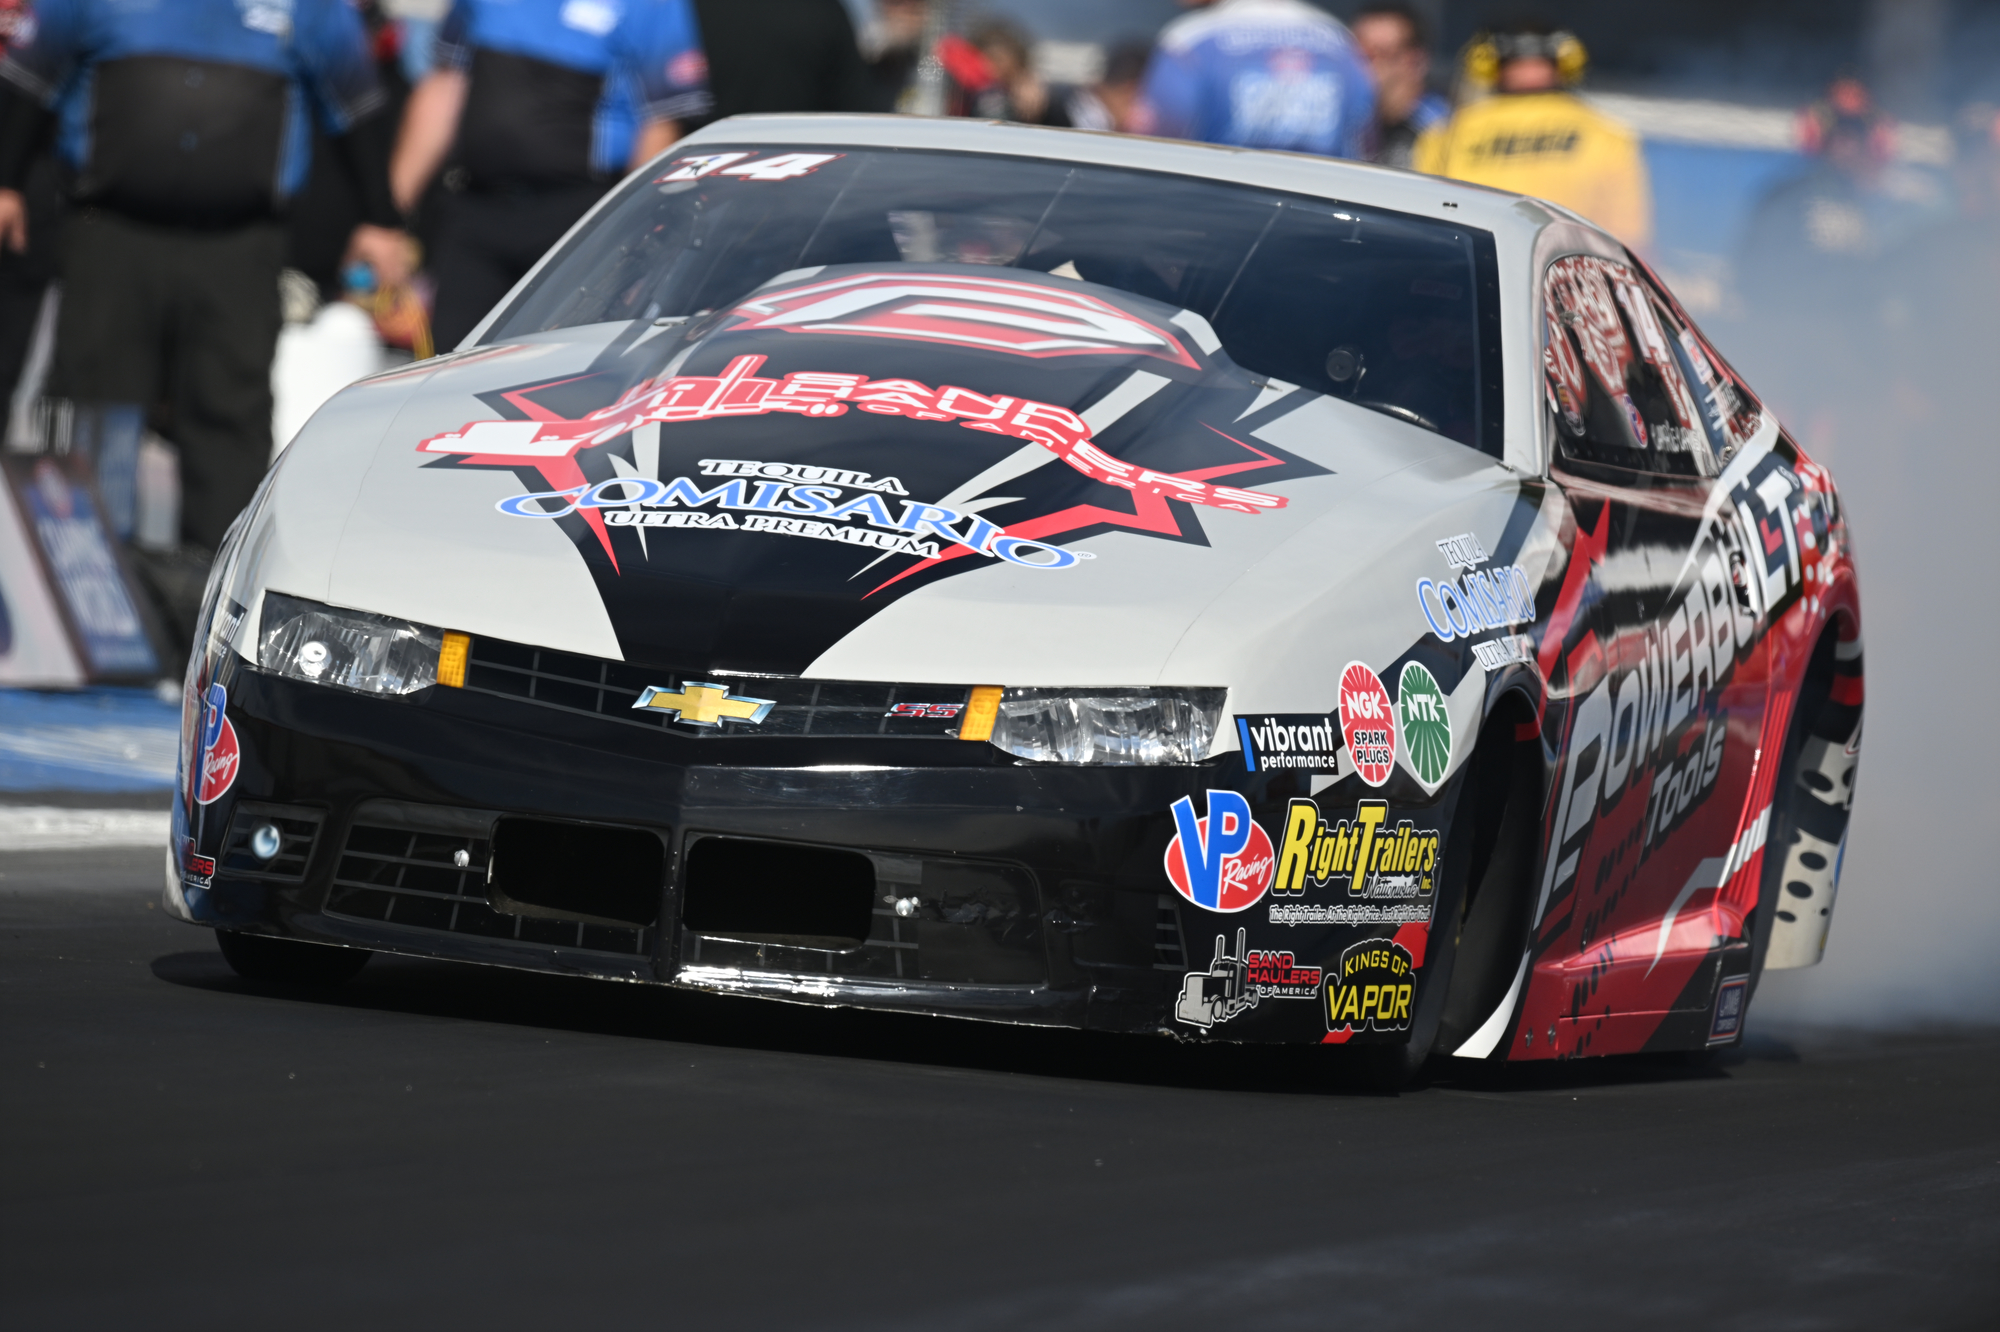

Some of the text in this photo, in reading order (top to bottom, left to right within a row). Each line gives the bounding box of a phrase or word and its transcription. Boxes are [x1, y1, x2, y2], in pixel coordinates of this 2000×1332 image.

[652, 152, 847, 183] 14
[866, 404, 1252, 512] OF AMERICA
[699, 459, 909, 496] TEQUILA
[604, 511, 941, 559] ULTRA PREMIUM
[1436, 533, 1488, 570] TEQUILA
[884, 703, 964, 718] SS
[1345, 691, 1384, 720] NGK
[1406, 693, 1440, 722] NTK
[1251, 717, 1333, 752] vibrant
[1354, 730, 1388, 746] SPARK
[203, 750, 239, 785] Racing
[1260, 751, 1335, 771] performance
[1356, 749, 1389, 765] PLUGS
[1170, 789, 1252, 909] VP
[1222, 854, 1273, 895] Racing
[1270, 906, 1283, 921] The
[1284, 906, 1302, 925] Right
[1249, 954, 1293, 969] SAND
[1345, 950, 1409, 977] KINGS OF
[1247, 969, 1320, 984] HAULERS
[1275, 987, 1315, 995] AMERICA
[1328, 984, 1412, 1020] VAPOR
